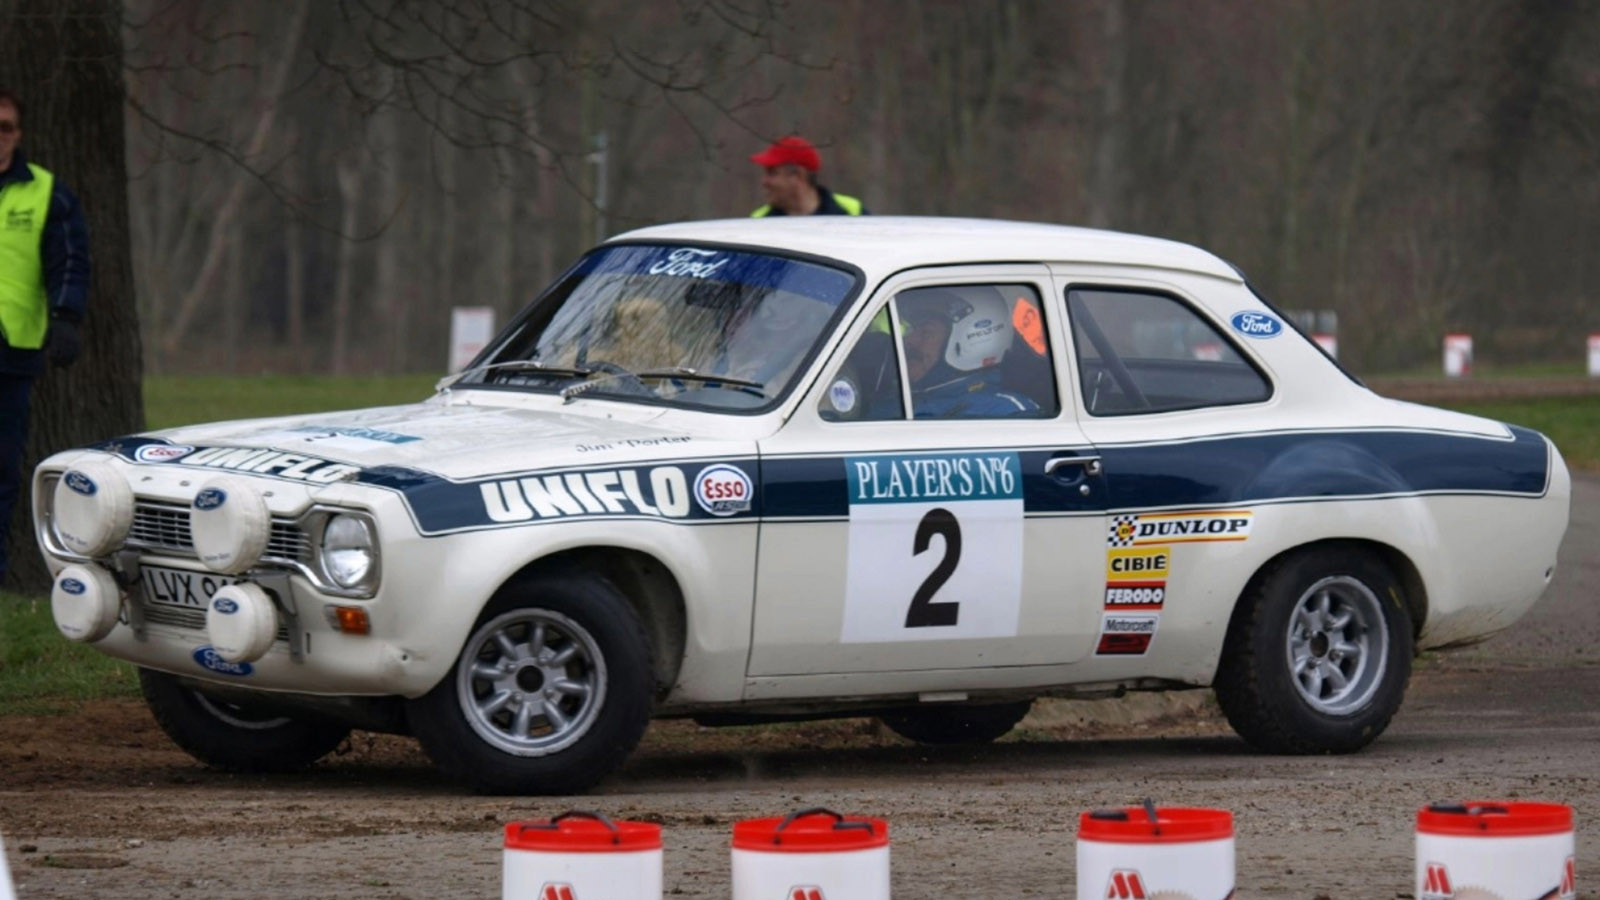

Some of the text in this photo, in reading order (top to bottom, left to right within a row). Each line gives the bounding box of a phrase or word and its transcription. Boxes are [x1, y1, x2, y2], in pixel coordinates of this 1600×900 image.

[649, 247, 729, 278] Ford
[1241, 314, 1273, 333] Ford
[180, 447, 361, 483] UNIFLO
[855, 457, 974, 499] PLAYER'S
[479, 466, 690, 522] UNIFLO
[1138, 519, 1249, 537] DUNLOP
[904, 507, 962, 628] 2
[147, 569, 200, 606] LVX
[1106, 588, 1164, 604] FERODO
